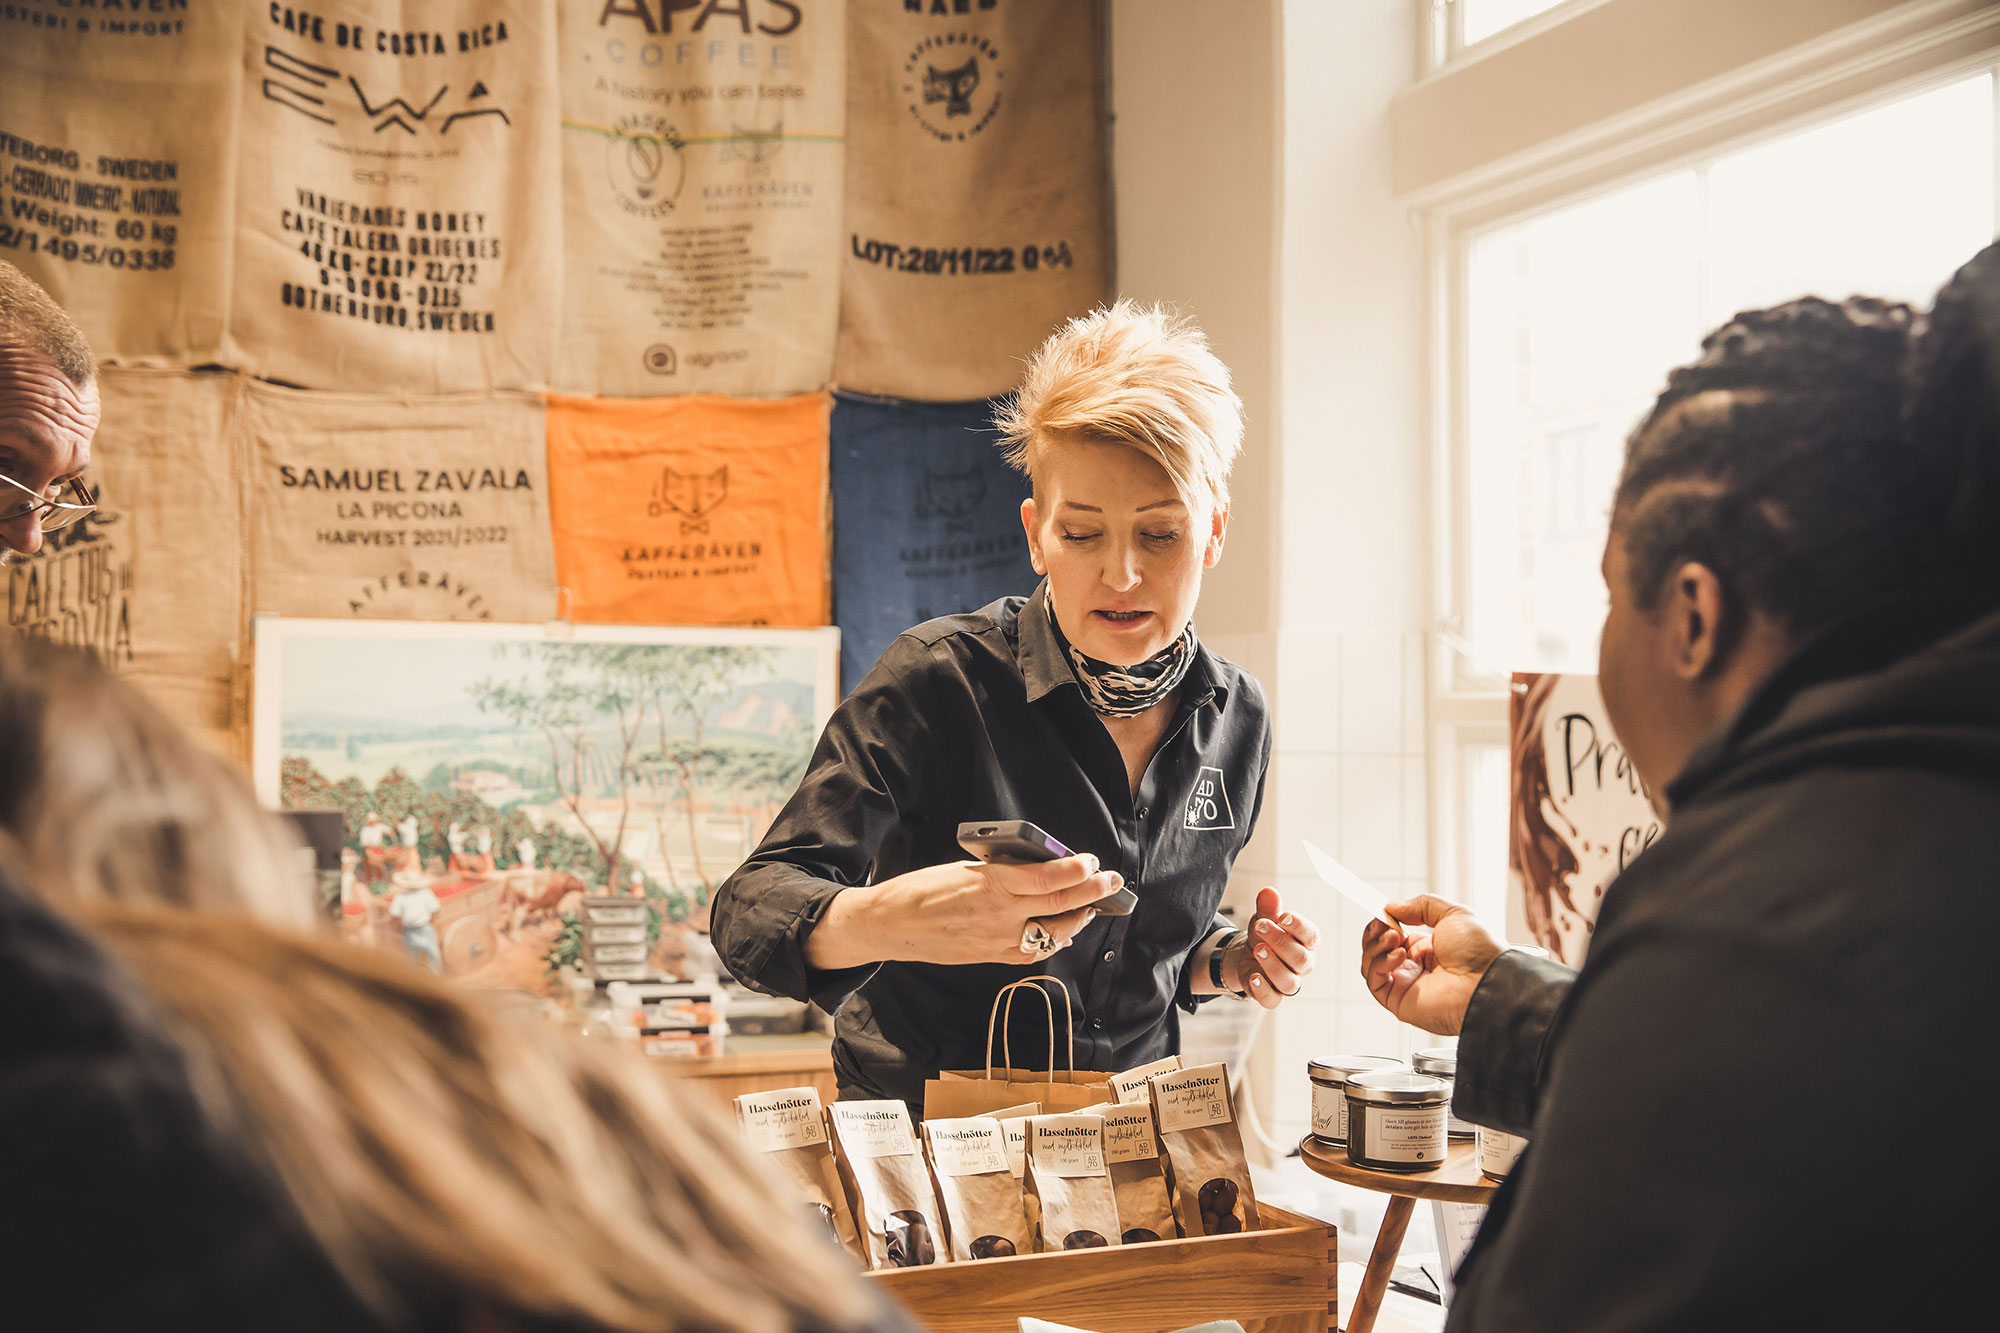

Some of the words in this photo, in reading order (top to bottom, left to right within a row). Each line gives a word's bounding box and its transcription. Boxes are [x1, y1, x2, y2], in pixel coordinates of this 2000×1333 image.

[269, 1, 324, 43] CAFE
[336, 22, 363, 50] DE
[376, 30, 446, 56] COSTA
[458, 20, 509, 51] RICA
[605, 38, 792, 69] COFFEE
[97, 155, 178, 181] SWEDEN
[116, 219, 145, 241] 60
[279, 464, 406, 492] SAMUEL
[415, 468, 533, 491] ZAVALA
[336, 500, 365, 521] LA
[372, 501, 463, 521] PICONA
[316, 526, 405, 546] HARVEST
[413, 526, 509, 549] 2021/2022
[1556, 713, 1650, 800] Pra
[1196, 779, 1214, 797] AD
[1195, 797, 1218, 820] 70
[1161, 1077, 1220, 1093] Hasselnötter
[749, 1098, 812, 1114] Hasselnötter
[841, 1110, 899, 1121] Hasselnötter
[935, 1129, 993, 1140] Hasselnötter
[1039, 1127, 1099, 1138] Hasselnötter
